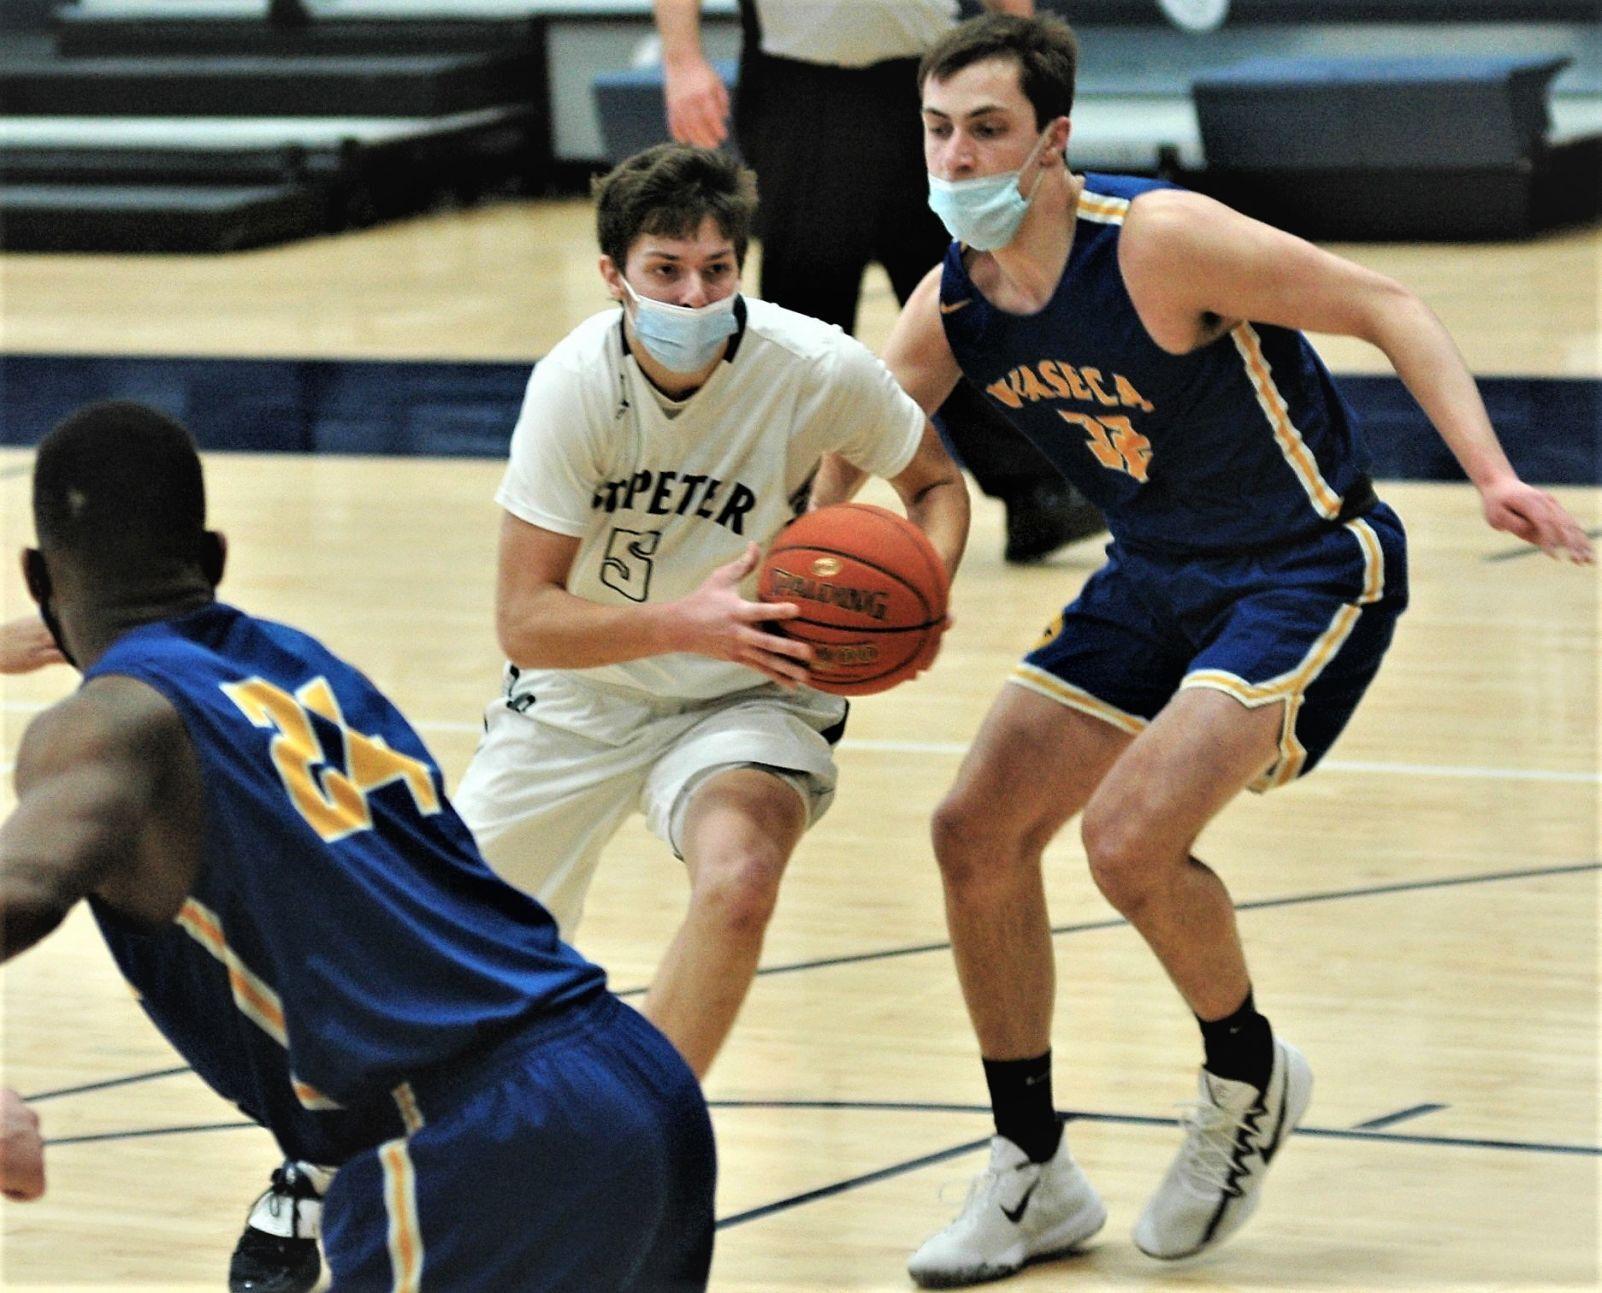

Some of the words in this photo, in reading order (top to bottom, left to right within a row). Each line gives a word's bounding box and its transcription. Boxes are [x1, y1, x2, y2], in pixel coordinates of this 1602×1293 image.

[985, 359, 1155, 413] WASECA
[1055, 407, 1154, 484] 32
[621, 468, 757, 536] PETER
[599, 527, 662, 603] 5
[217, 674, 443, 844] 24
